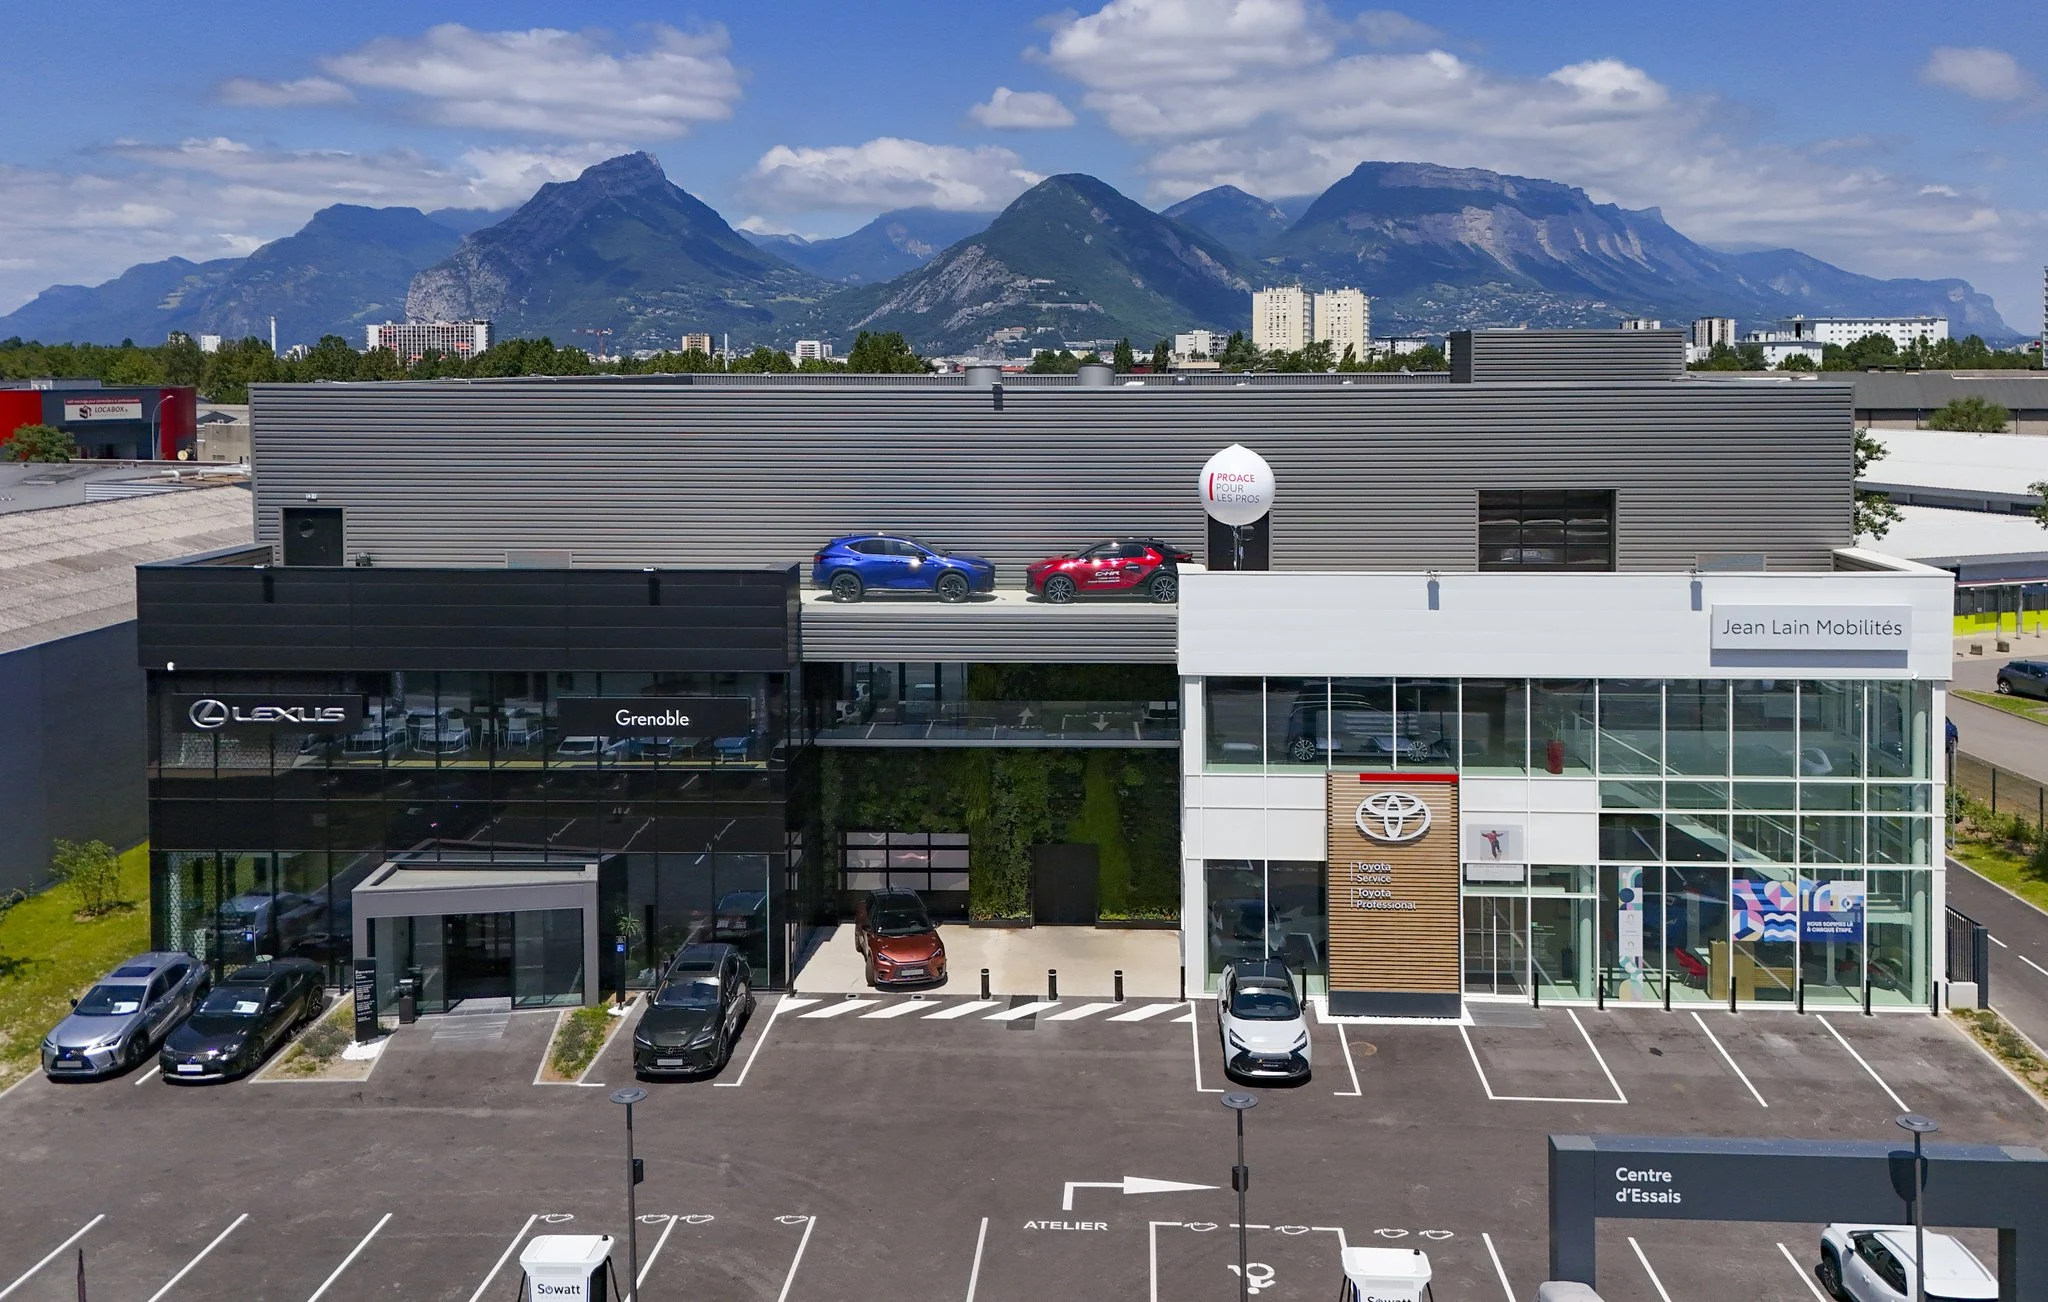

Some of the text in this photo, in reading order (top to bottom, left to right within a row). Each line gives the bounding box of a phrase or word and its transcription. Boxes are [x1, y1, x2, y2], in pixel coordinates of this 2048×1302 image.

[1216, 472, 1256, 483] PROACE
[1216, 483, 1244, 493] POUR
[1216, 494, 1260, 504] LES PROS
[1722, 619, 1903, 636] Jean Lain Mobilités
[231, 706, 346, 723] LEXUS
[615, 709, 690, 726] Grenoble
[1356, 861, 1391, 873] Toyota
[1356, 873, 1392, 883] Service
[1356, 887, 1392, 899] Toyota
[1356, 899, 1417, 910] Professional
[1615, 1166, 1673, 1182] Centre
[1615, 1187, 1682, 1204] d'Essais
[1023, 1220, 1109, 1231] ATELIER
[537, 1283, 581, 1295] Sowatt
